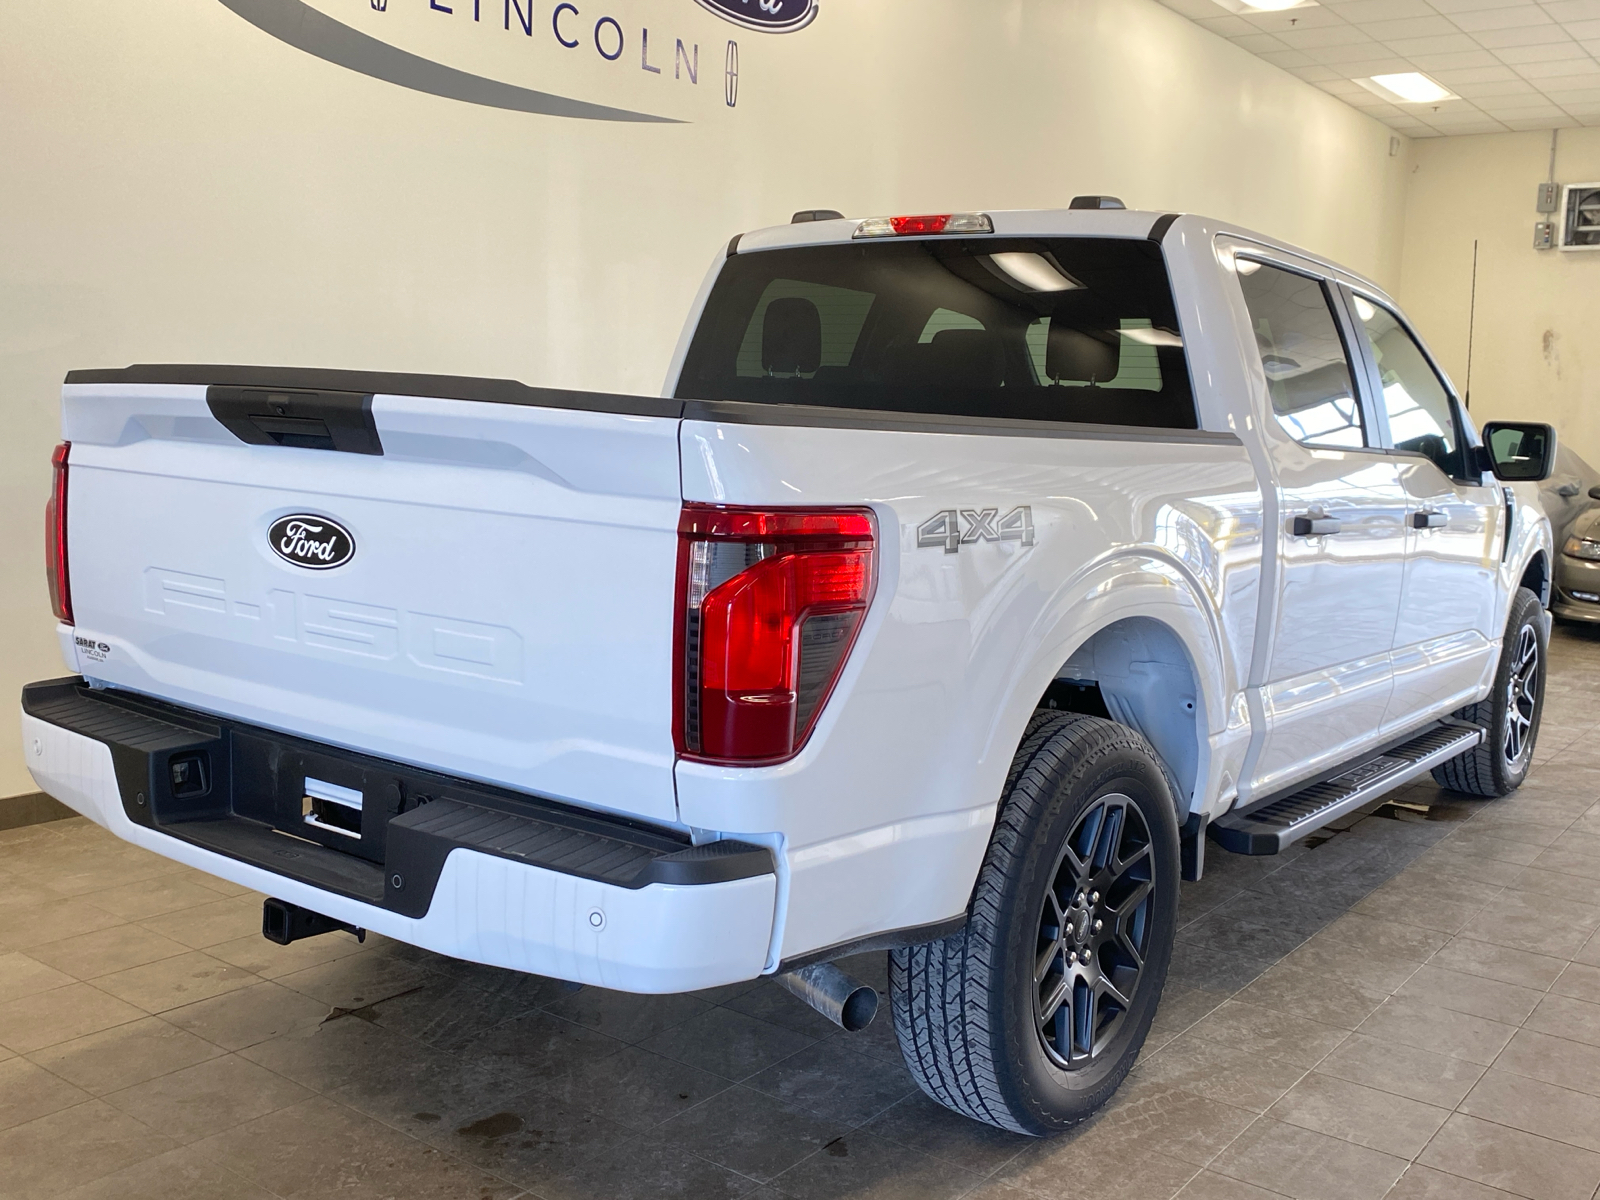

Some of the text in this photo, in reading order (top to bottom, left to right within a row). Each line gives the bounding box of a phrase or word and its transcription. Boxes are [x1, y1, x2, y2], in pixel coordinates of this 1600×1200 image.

[430, 0, 698, 85] NCOLN
[281, 521, 337, 561] Ford
[917, 505, 1034, 554] 4X4
[75, 636, 96, 650] SARAT
[144, 566, 523, 686] F-150
[81, 647, 107, 659] LINCOLN
